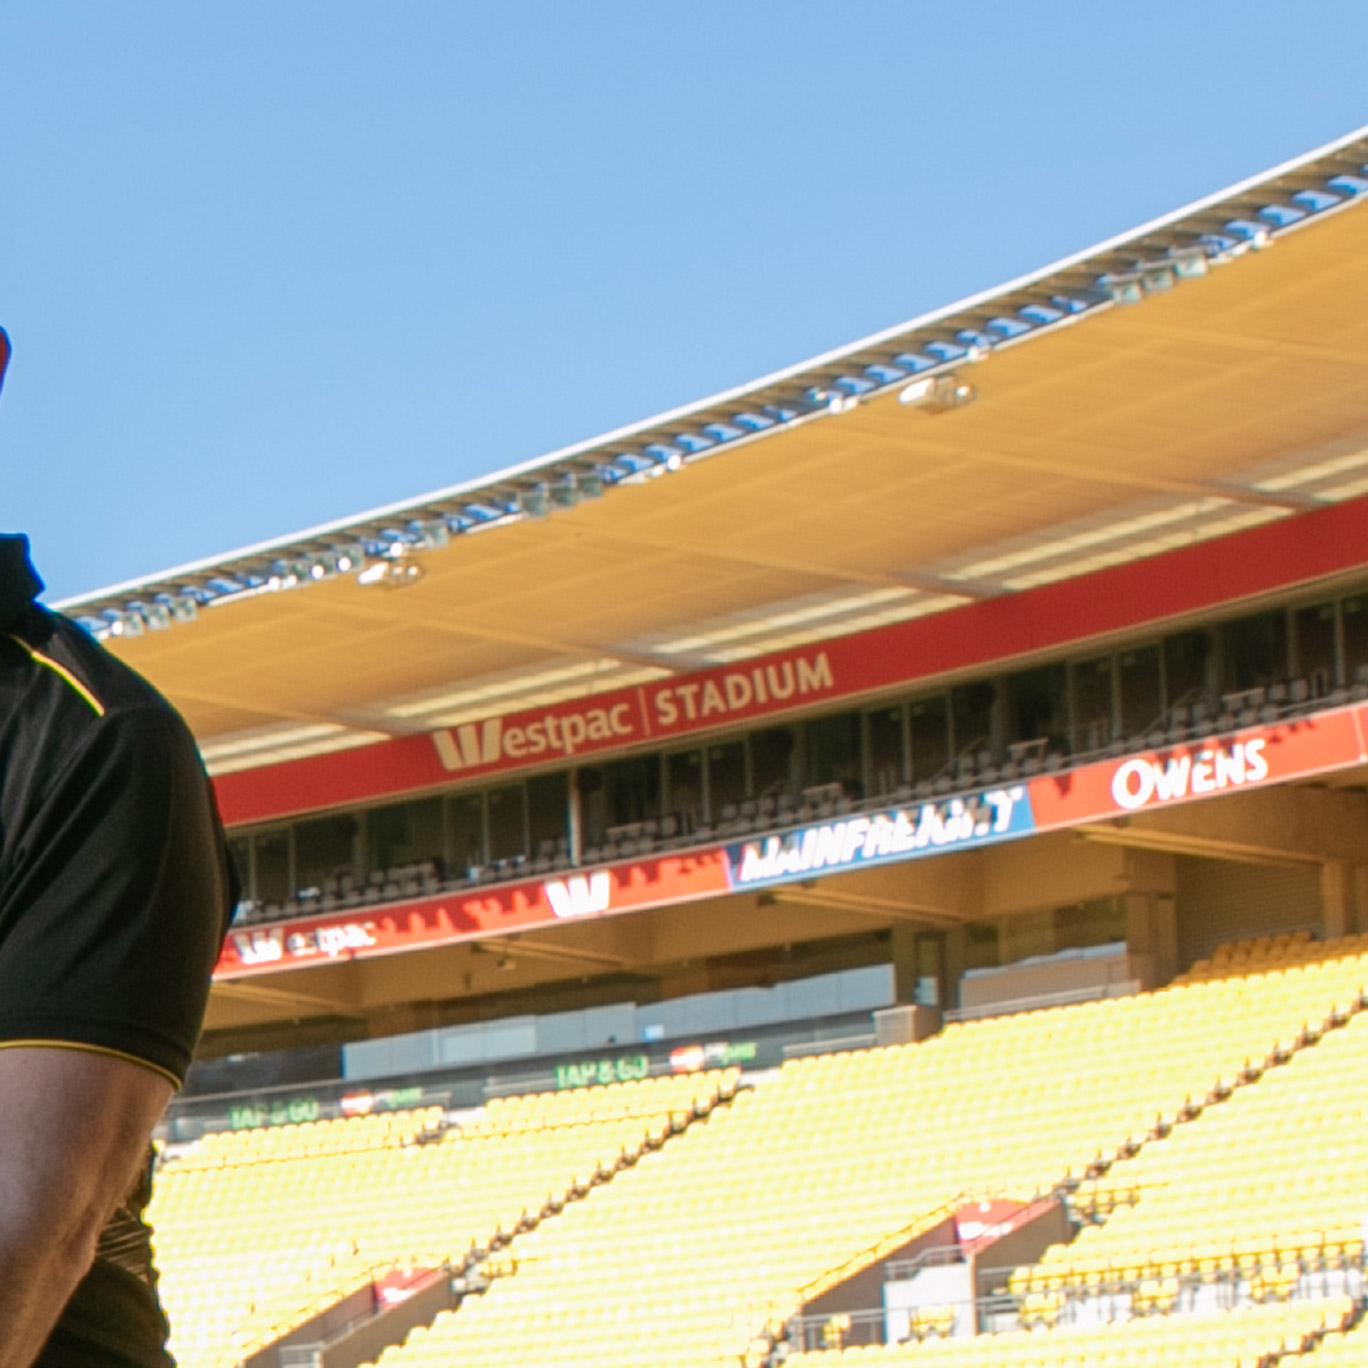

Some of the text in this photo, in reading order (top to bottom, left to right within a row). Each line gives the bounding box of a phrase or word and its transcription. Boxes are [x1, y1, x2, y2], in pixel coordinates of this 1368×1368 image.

[431, 651, 835, 773] Westpac STADIUM
[1111, 739, 1268, 811] OWENS
